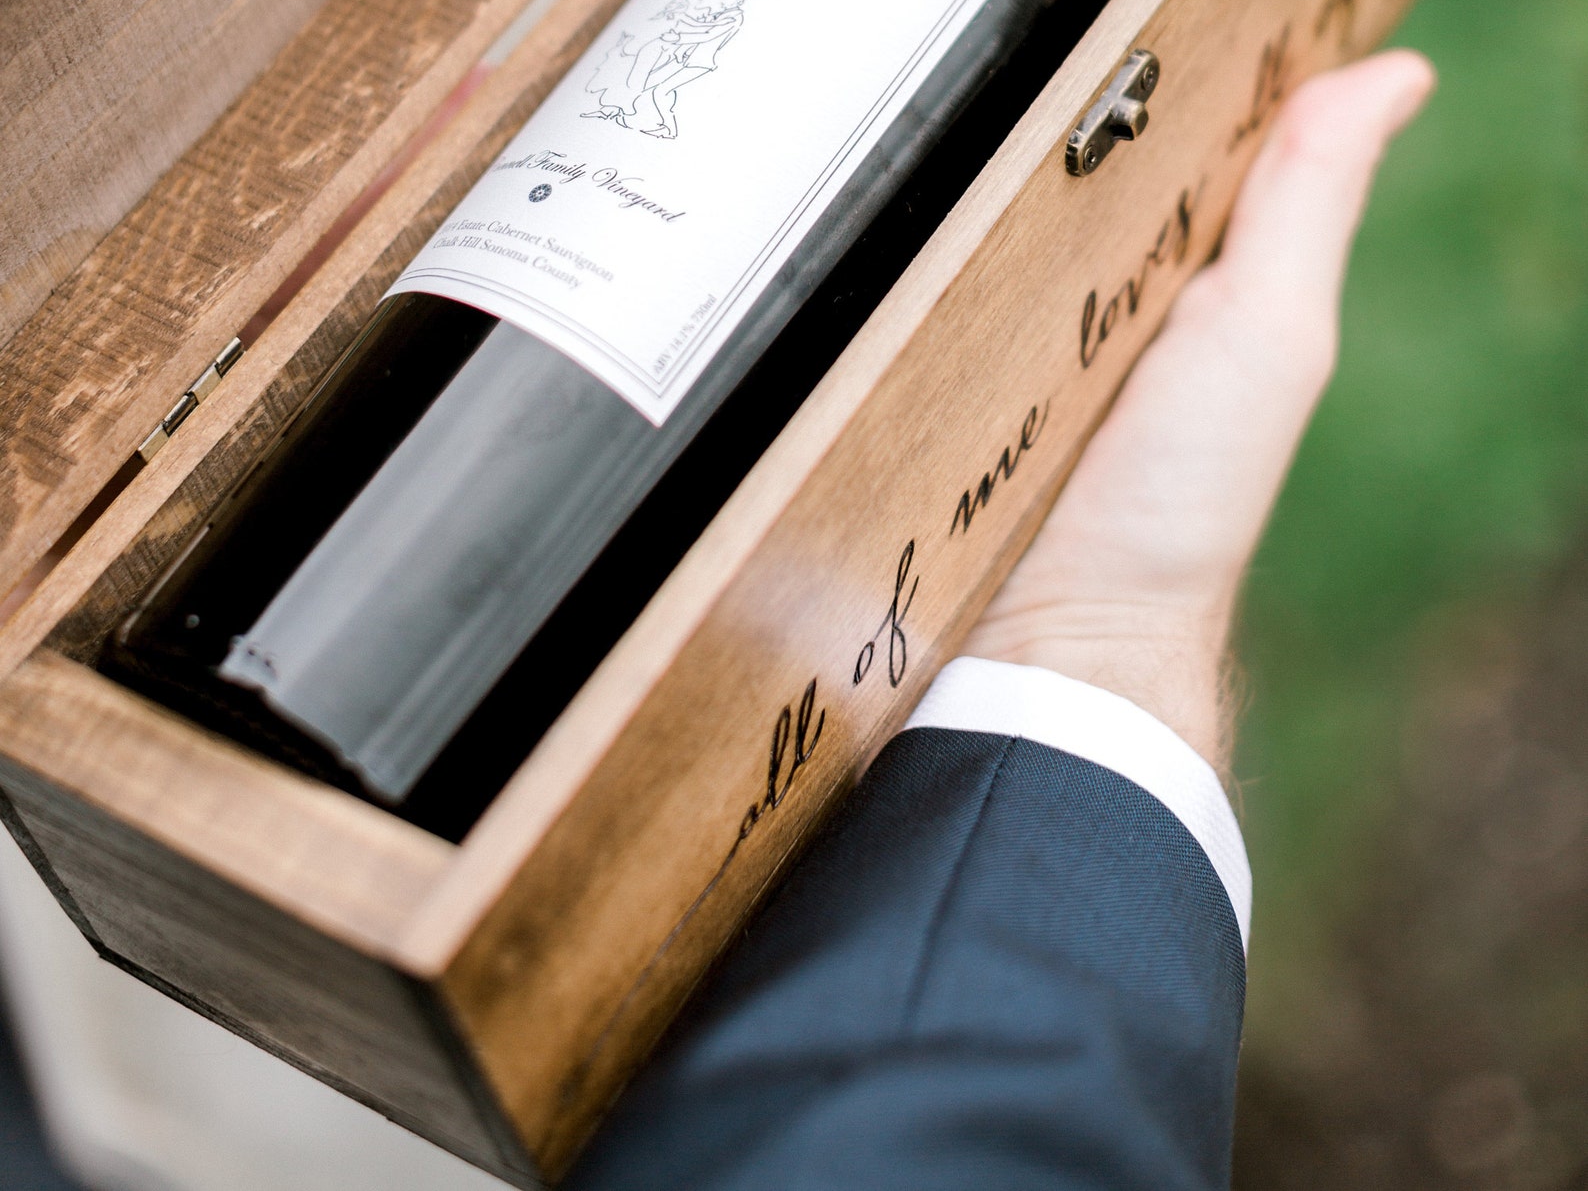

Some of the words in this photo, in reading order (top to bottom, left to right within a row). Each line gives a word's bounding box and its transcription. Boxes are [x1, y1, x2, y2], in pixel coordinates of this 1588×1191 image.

[527, 149, 587, 185] Family
[591, 166, 686, 224] Vineyard
[457, 219, 487, 232] Estate
[487, 219, 544, 246] Cabernet
[542, 237, 615, 283] Sauvignon
[458, 235, 483, 249] Hill
[480, 238, 530, 264] Sonoma
[531, 253, 584, 290] County
[690, 293, 718, 322] 750ml
[853, 537, 921, 689] of
[948, 395, 1051, 538] me
[1077, 173, 1210, 371] loves
